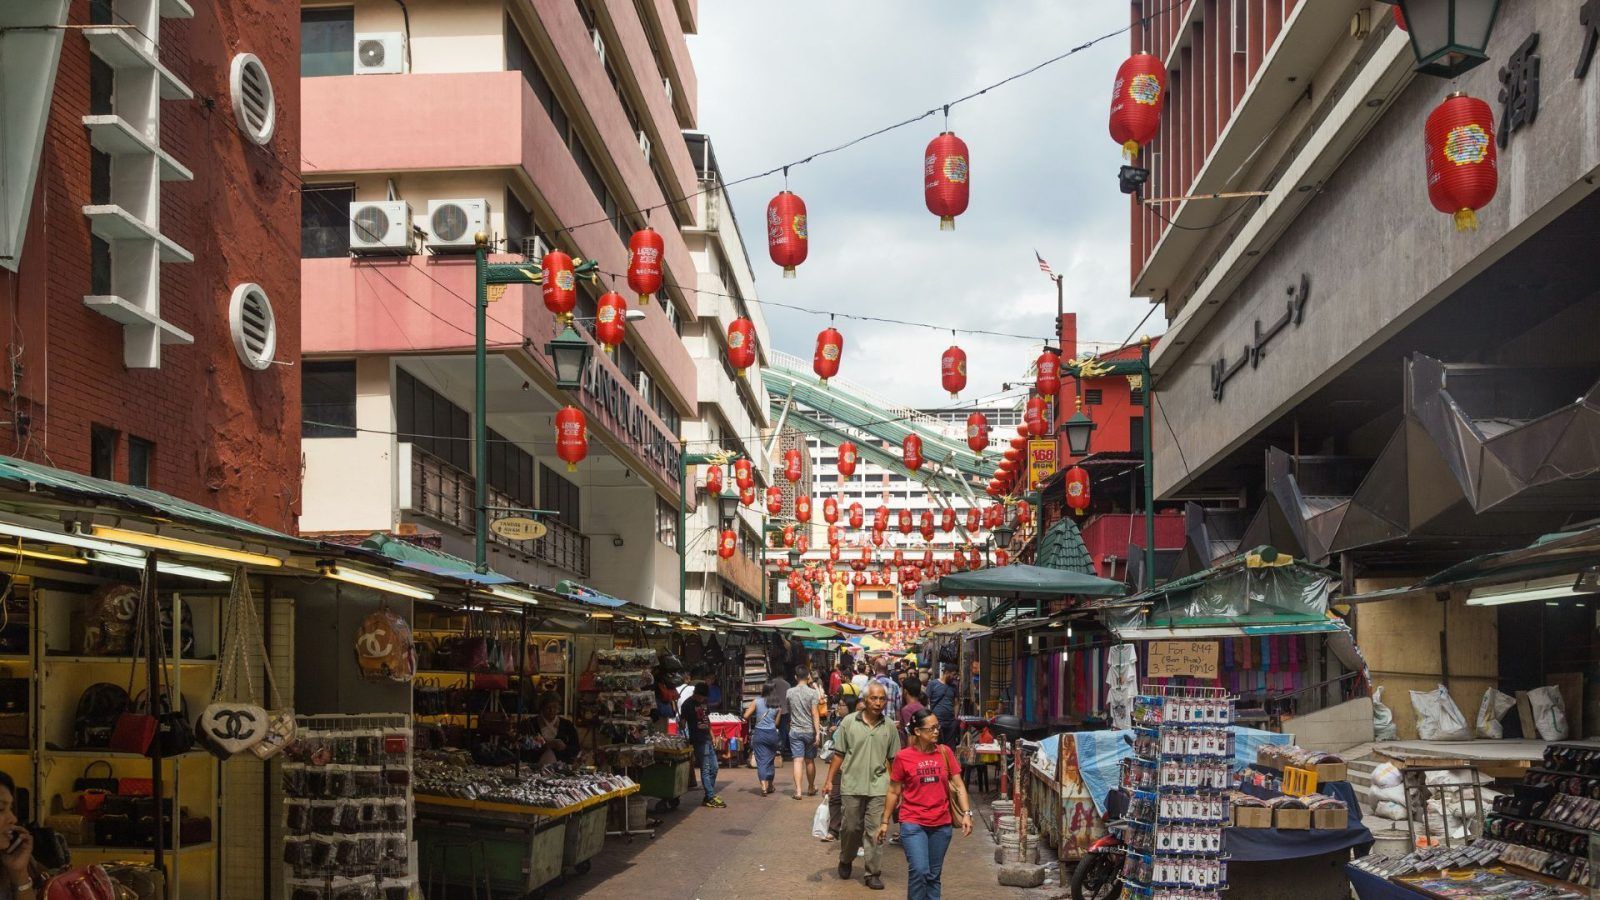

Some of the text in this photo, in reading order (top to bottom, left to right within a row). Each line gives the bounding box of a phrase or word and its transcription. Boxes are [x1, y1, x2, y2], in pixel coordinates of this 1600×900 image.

[1033, 449, 1054, 460] 168
[1150, 643, 1213, 655] 1 For RM4
[1166, 665, 1182, 673] For
[1190, 663, 1215, 673] RM10
[917, 767, 941, 776] EIGHT
